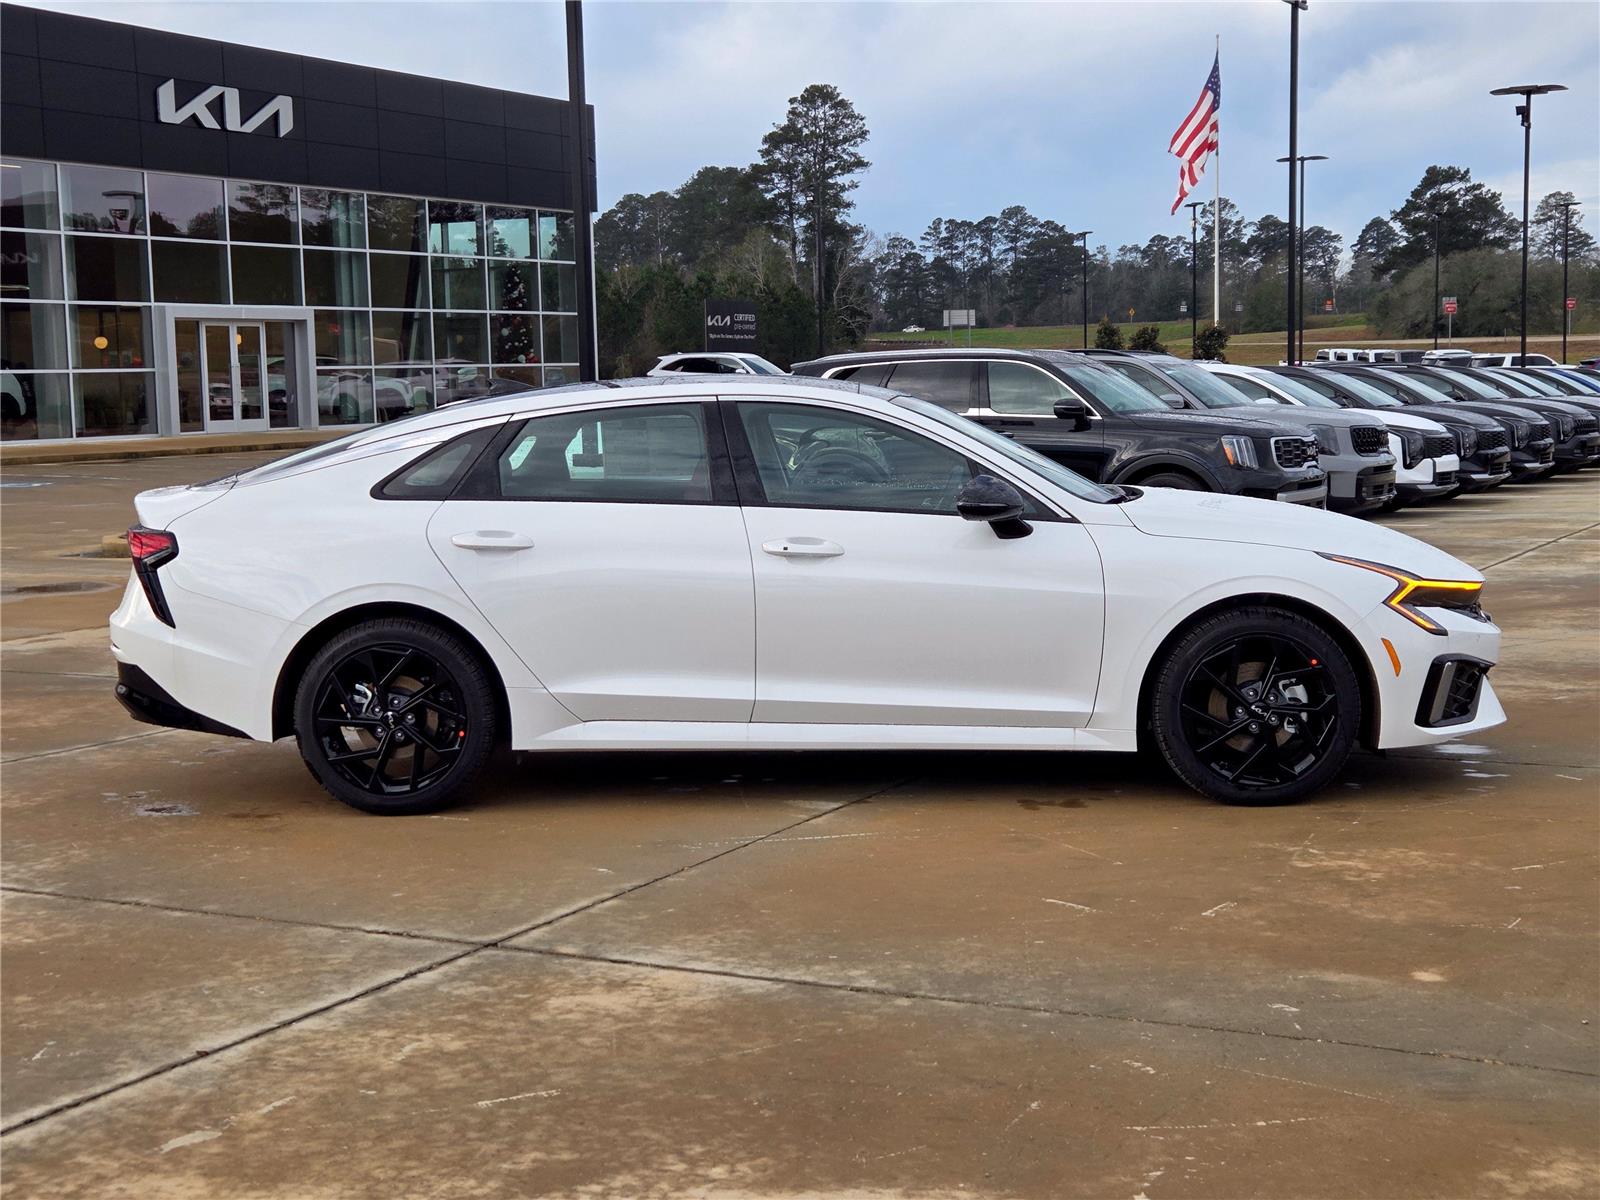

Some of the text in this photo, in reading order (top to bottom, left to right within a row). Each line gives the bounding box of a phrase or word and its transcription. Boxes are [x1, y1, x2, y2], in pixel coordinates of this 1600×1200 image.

[156, 78, 294, 138] KIA
[707, 314, 731, 326] KIA
[733, 313, 756, 322] CERTIFIED
